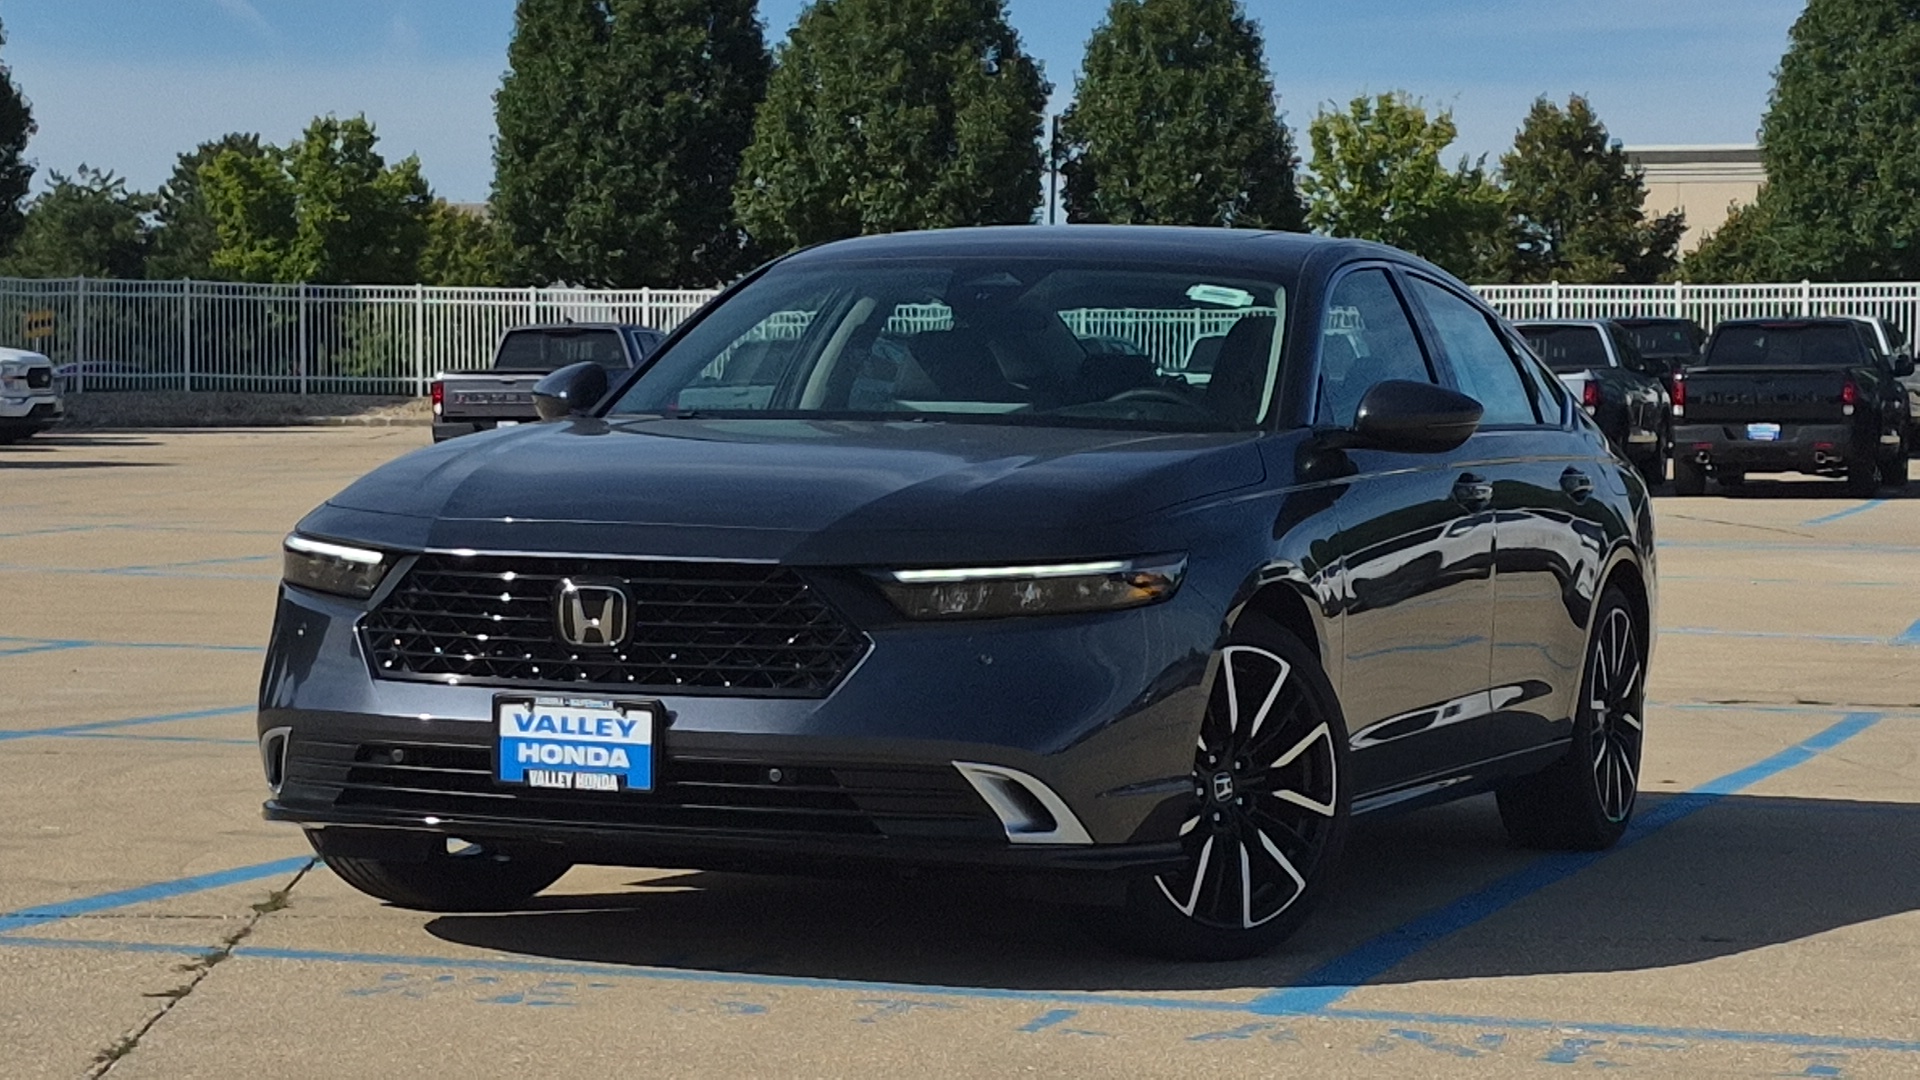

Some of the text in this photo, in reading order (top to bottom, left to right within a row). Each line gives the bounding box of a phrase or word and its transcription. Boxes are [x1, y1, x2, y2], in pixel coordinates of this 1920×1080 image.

[513, 713, 638, 738] VALLEY
[517, 742, 630, 768] HONDA
[529, 770, 619, 792] VALLEY HONDA
